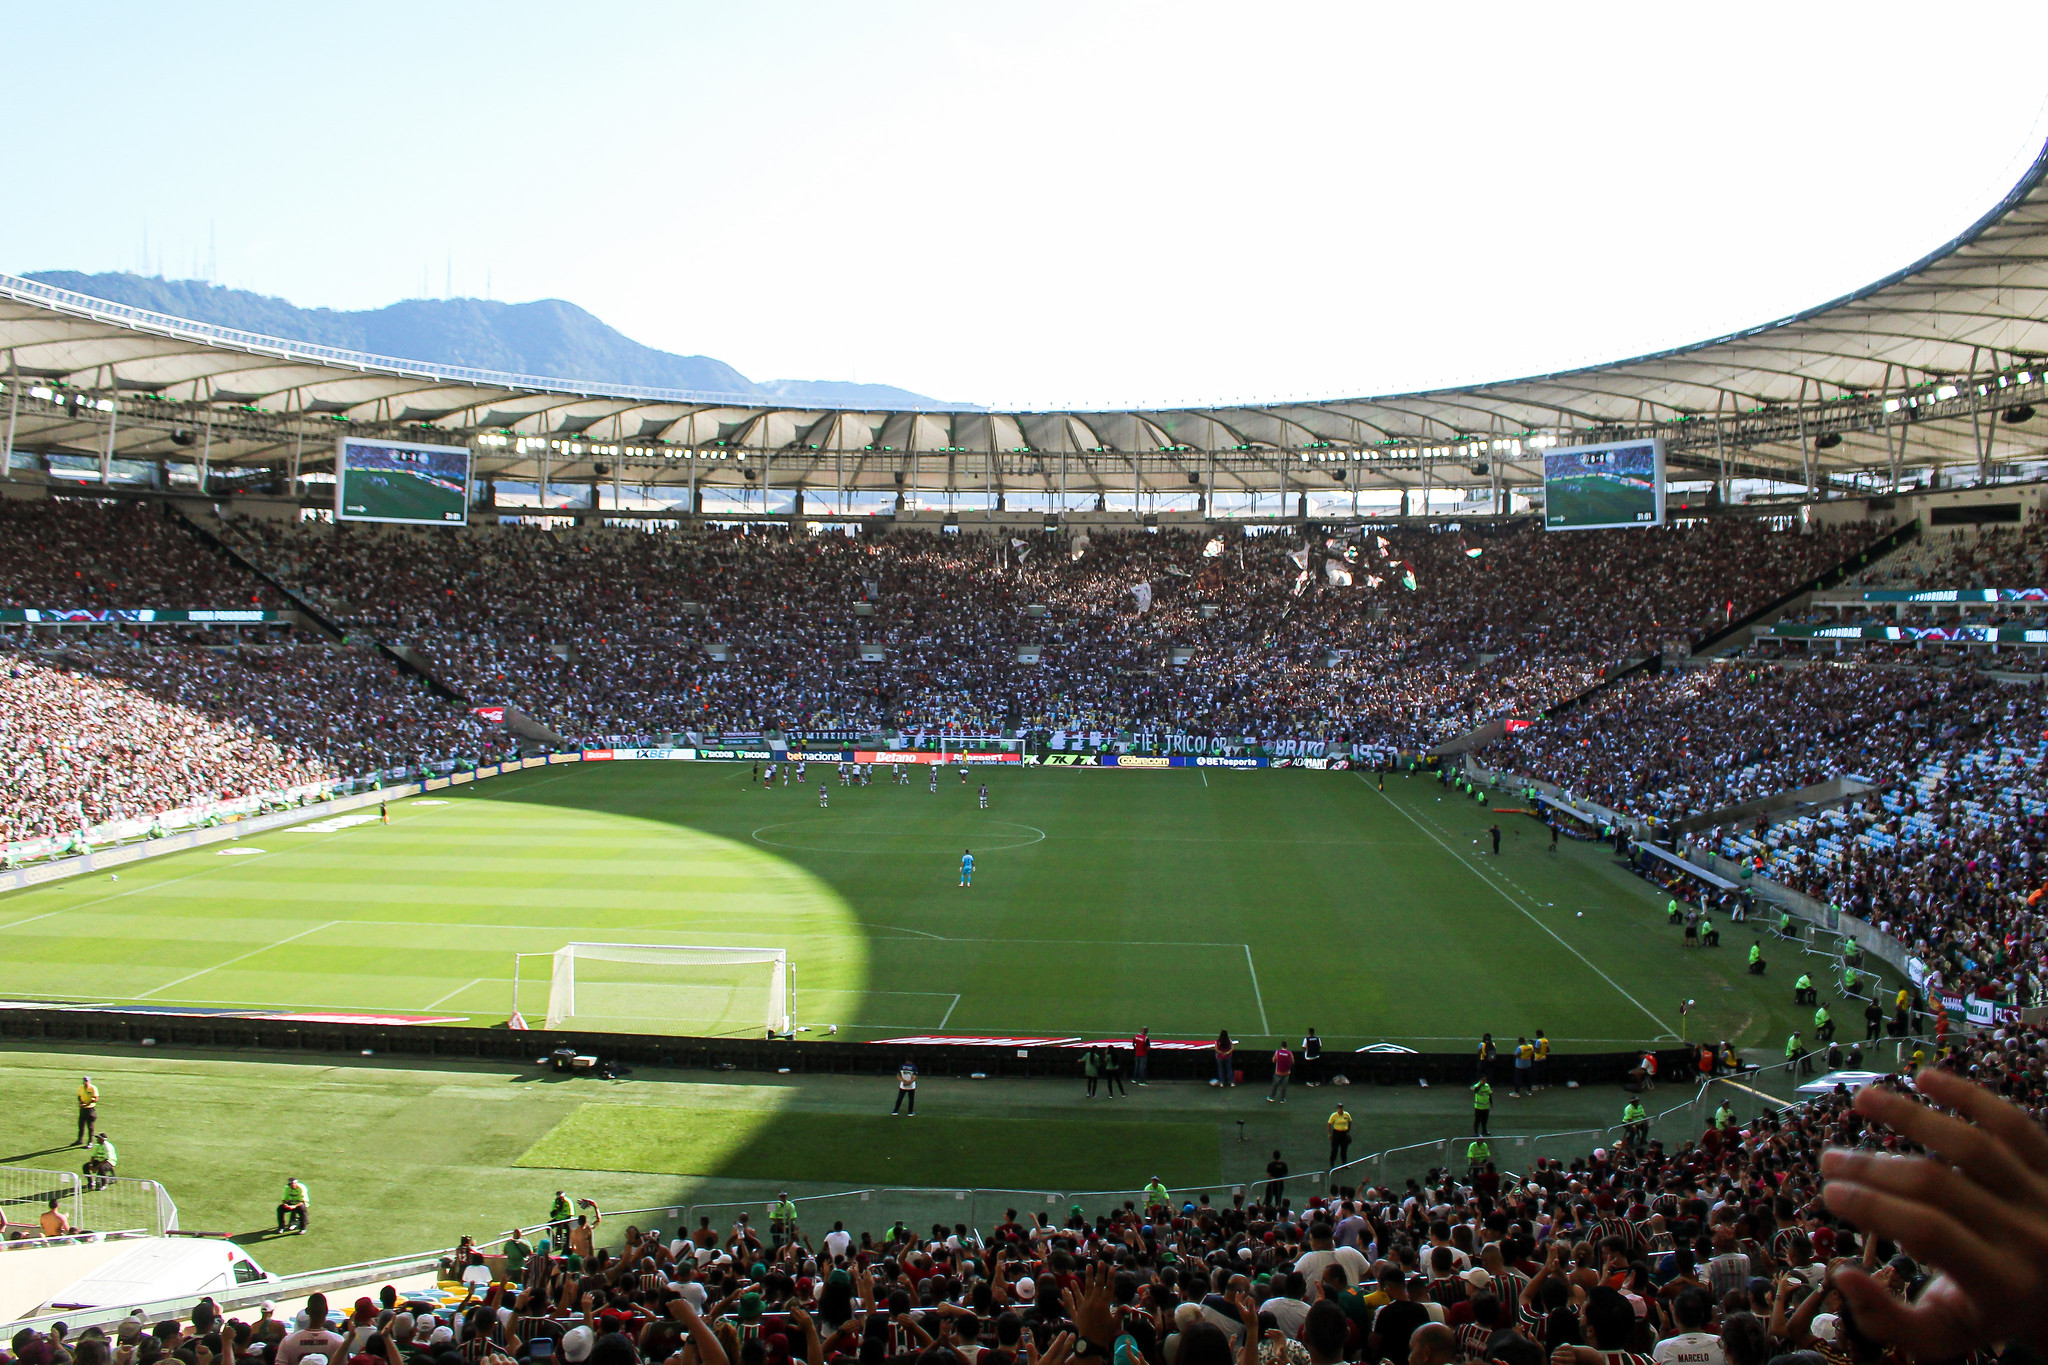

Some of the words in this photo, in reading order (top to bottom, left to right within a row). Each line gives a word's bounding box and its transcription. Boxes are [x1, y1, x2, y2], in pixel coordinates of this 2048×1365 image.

[636, 749, 673, 759] 1XBET
[708, 751, 735, 759] SICOOB
[744, 751, 771, 759] SICOOB
[786, 751, 843, 762] betnacional
[875, 752, 917, 763] Betano
[1051, 755, 1068, 764] 7K
[1080, 755, 1098, 765] 7K
[1678, 1353, 1710, 1363] MARCELO
